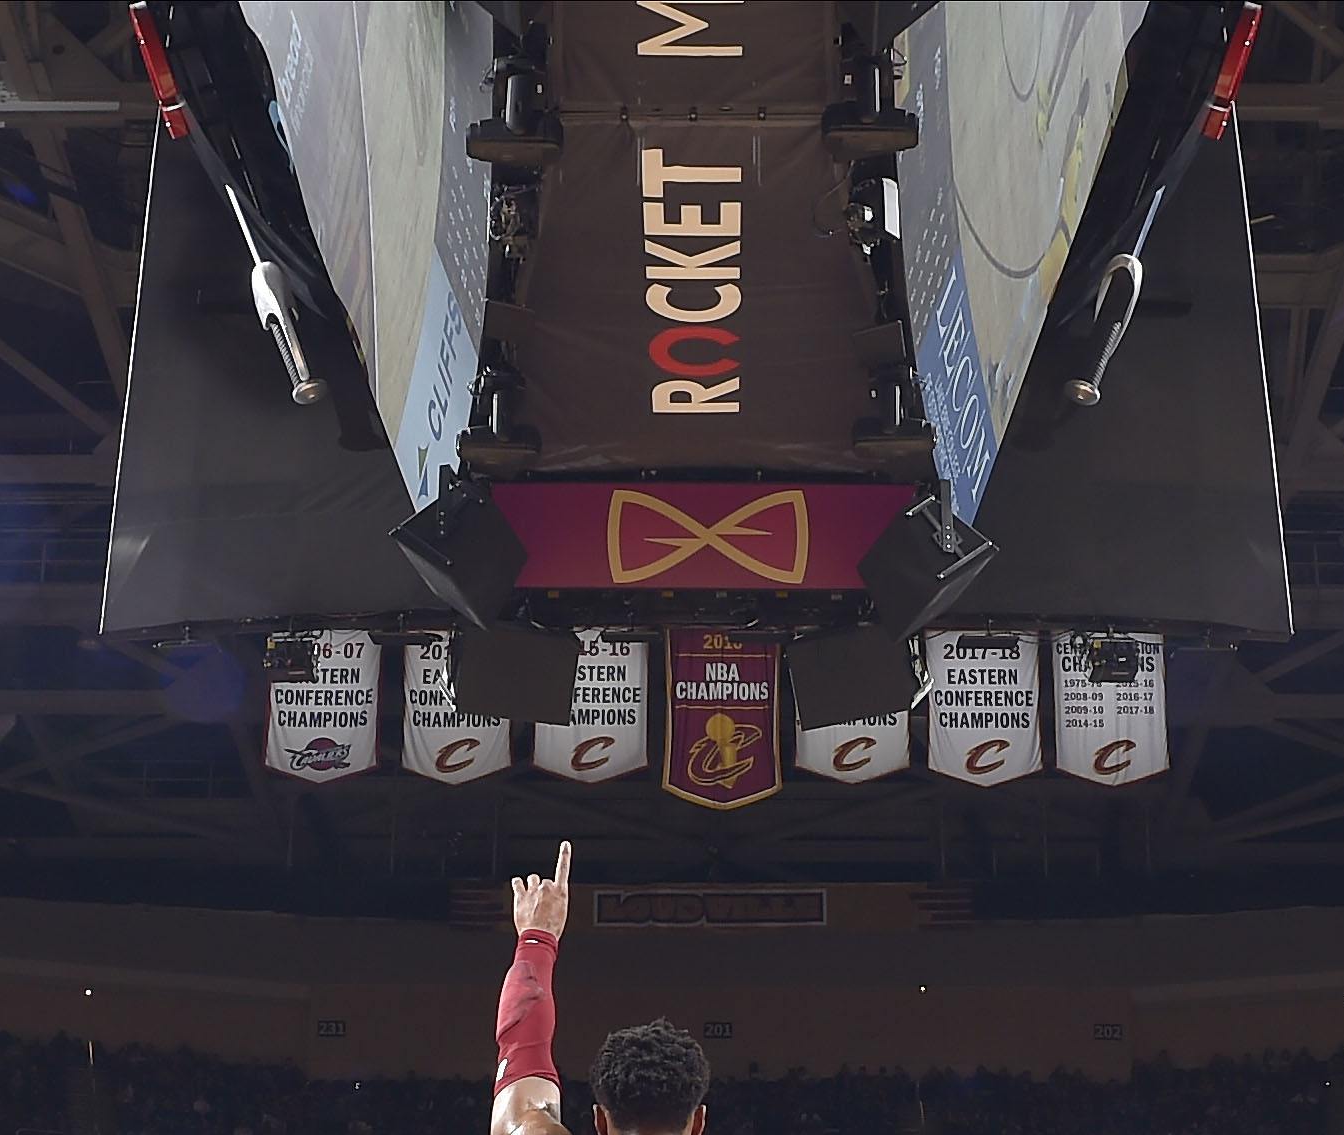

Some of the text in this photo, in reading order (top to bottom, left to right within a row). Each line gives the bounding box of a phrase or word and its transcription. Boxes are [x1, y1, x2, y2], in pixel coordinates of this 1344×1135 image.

[641, 148, 743, 413] ROCKET
[426, 290, 463, 442] CLIFFS
[705, 662, 740, 682] NBA
[947, 668, 1018, 686] EASTERN
[274, 688, 374, 705] CONFERENCE
[675, 681, 769, 701] CHAMPIONS
[934, 690, 1034, 707] CONFERENCE
[277, 710, 369, 729] CHAMPIONS
[939, 711, 1030, 729] CHAMPIONS
